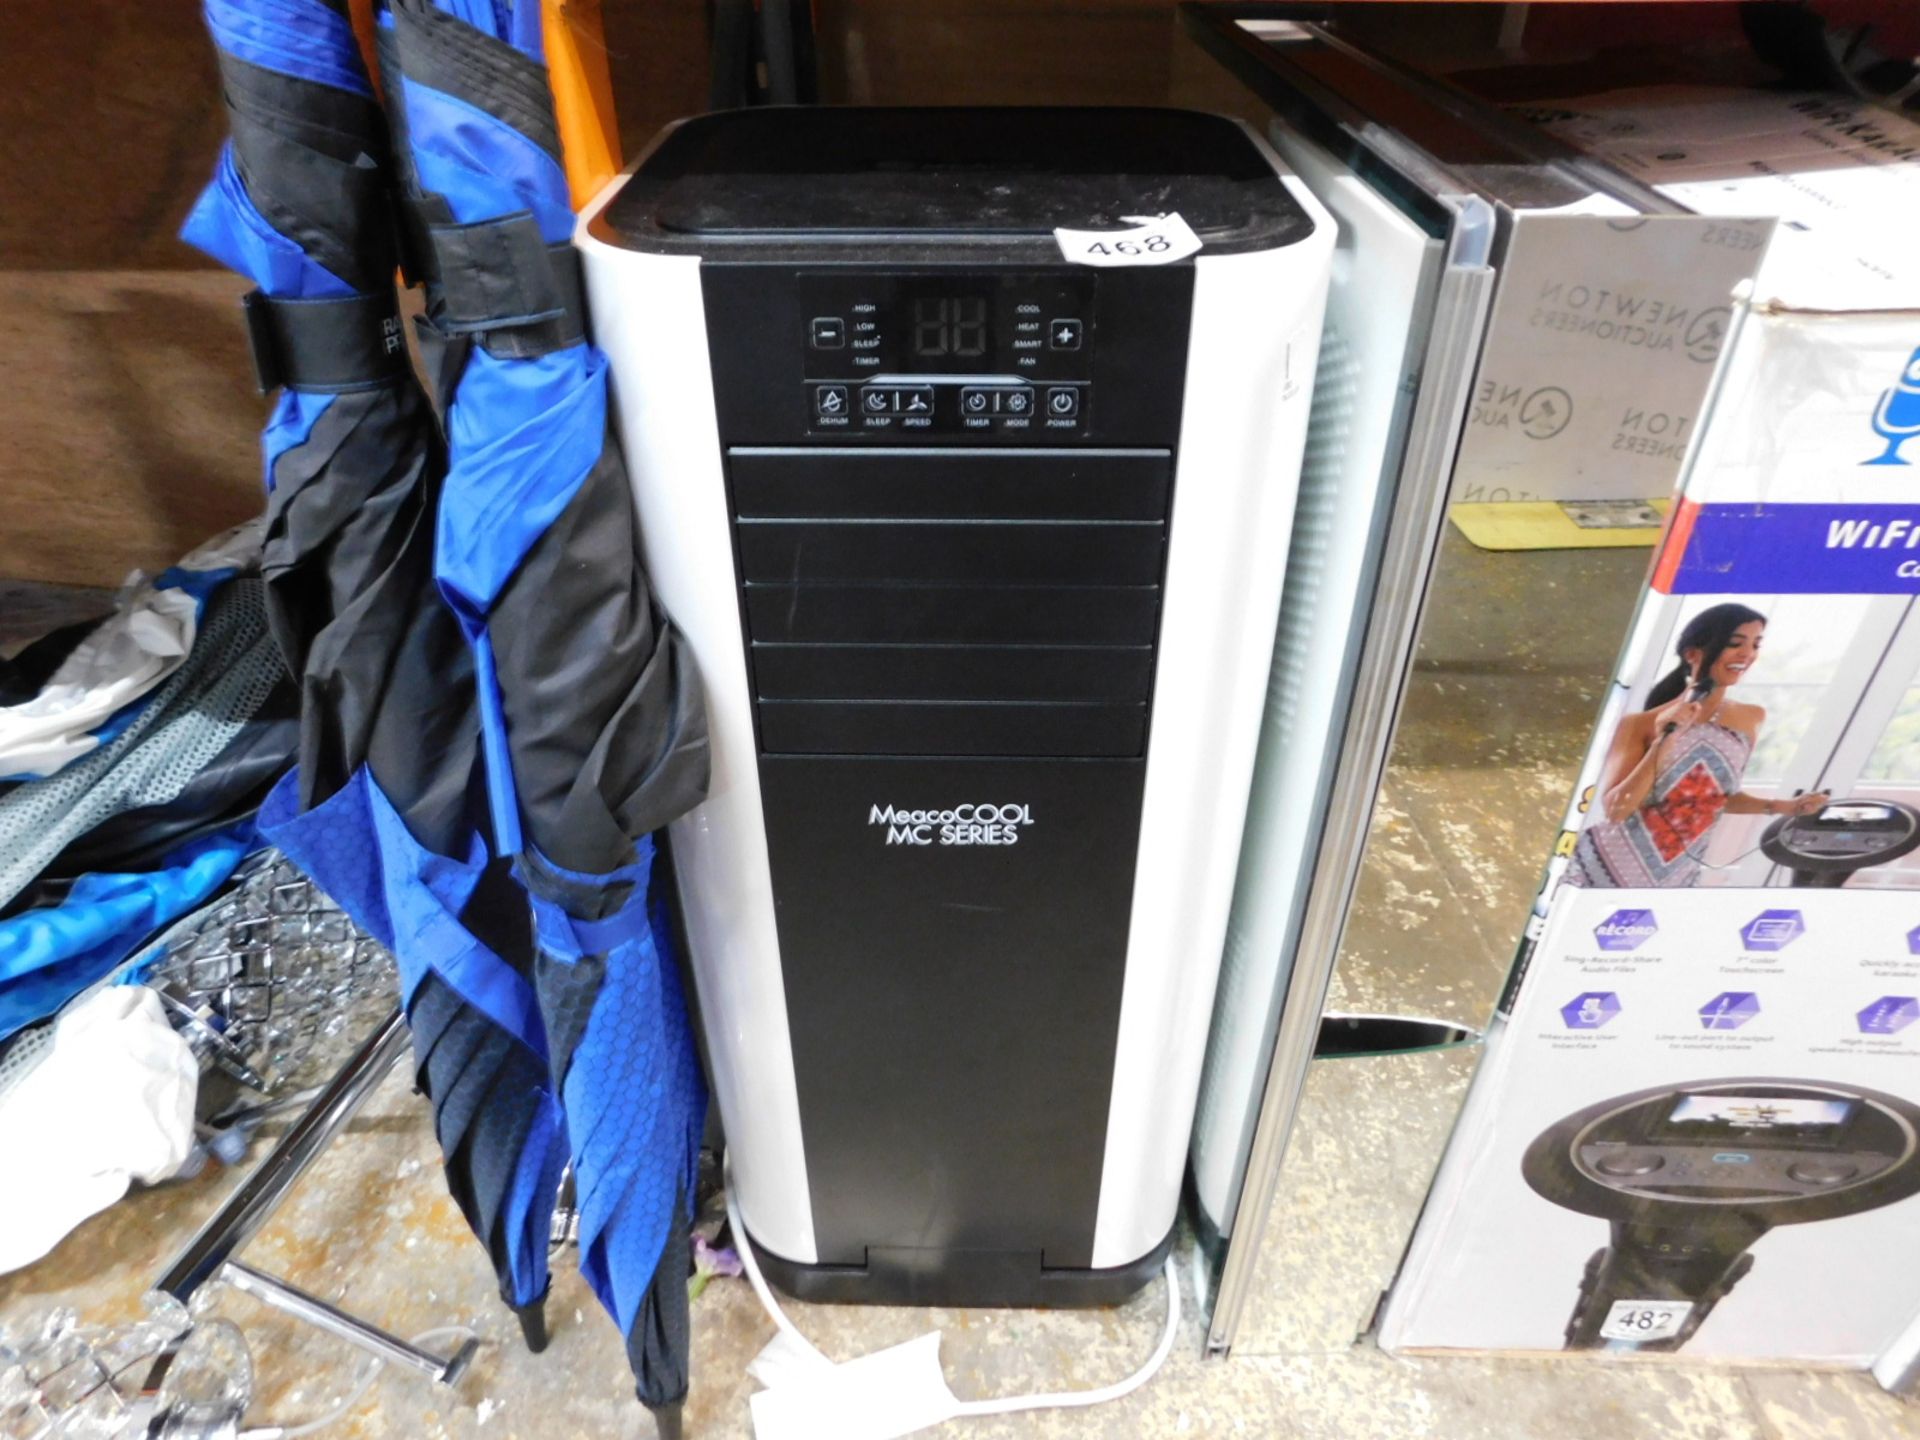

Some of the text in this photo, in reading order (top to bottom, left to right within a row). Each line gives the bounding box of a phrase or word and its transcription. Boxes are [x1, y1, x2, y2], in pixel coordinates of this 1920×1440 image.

[1087, 235, 1171, 256] 468
[853, 304, 876, 312] HIGH
[1016, 304, 1041, 313] COOL
[856, 322, 875, 331] LOW
[1017, 322, 1040, 331] HEAT
[853, 339, 880, 348] SLEEP
[1014, 339, 1042, 348] SMART
[853, 357, 880, 366] TIMER
[1017, 357, 1036, 366] FAN
[819, 416, 849, 425] DEHUM
[865, 417, 891, 426] SLEEP
[903, 417, 932, 427] SPEED
[965, 418, 991, 427] TIMER
[1004, 418, 1030, 427] MODE
[1047, 418, 1077, 427] POWER
[868, 803, 1035, 825] MeacoCOOL
[886, 823, 1019, 846] MC SERIES
[1618, 1310, 1673, 1331] 482
